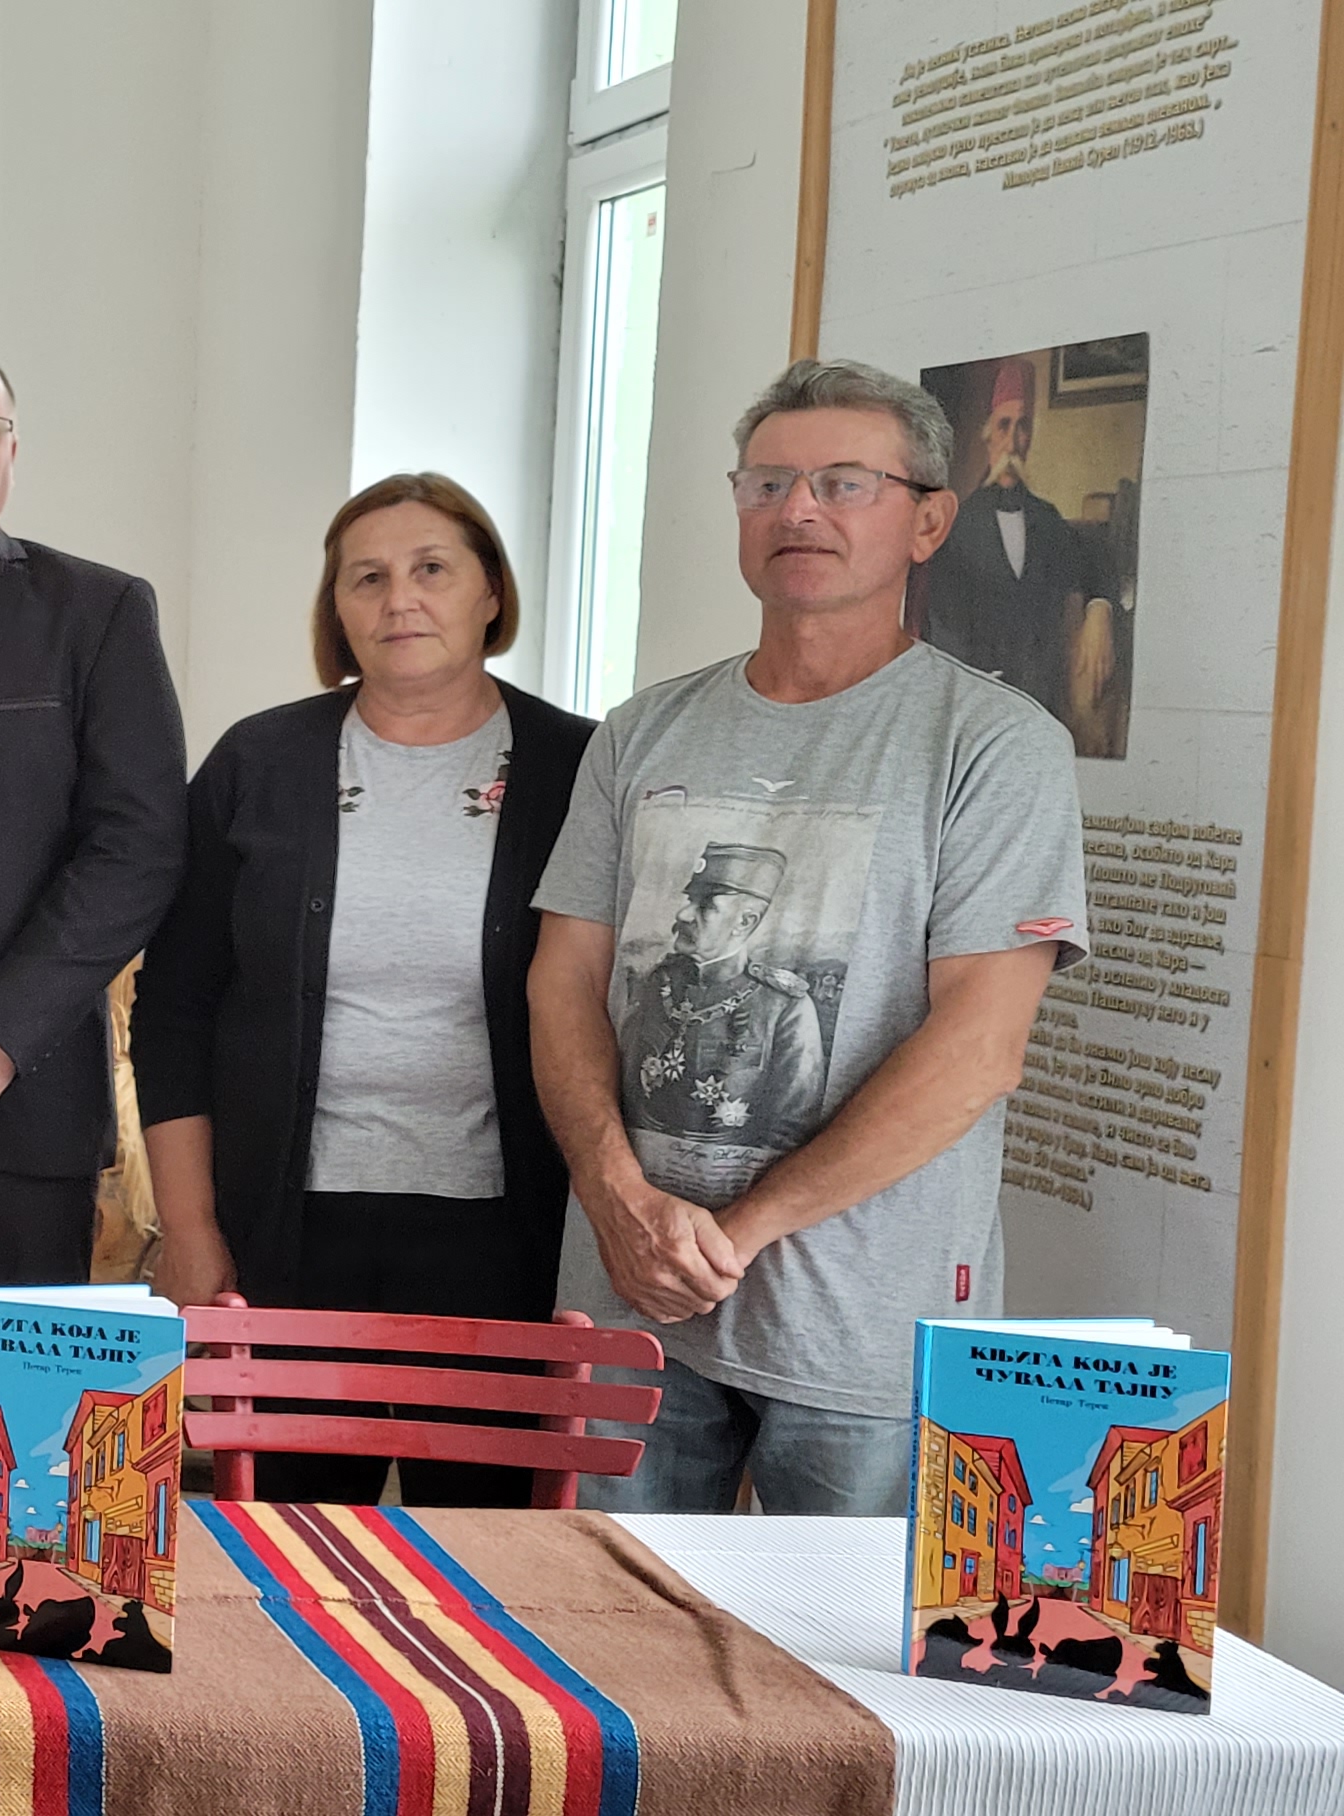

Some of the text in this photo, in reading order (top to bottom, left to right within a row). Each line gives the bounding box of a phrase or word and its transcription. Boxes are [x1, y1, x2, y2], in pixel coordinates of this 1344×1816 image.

[1081, 814, 1243, 847] амилијом својом побегне
[1131, 841, 1184, 868] особито
[1185, 850, 1203, 871] од
[1203, 850, 1238, 876] Кара
[51, 1322, 108, 1342] КОЈА
[114, 1329, 141, 1344] ЈЕ
[969, 1345, 1178, 1380] КЊИГА КОЈА ЈЕ
[975, 1367, 1086, 1392] ЧУВАЛА
